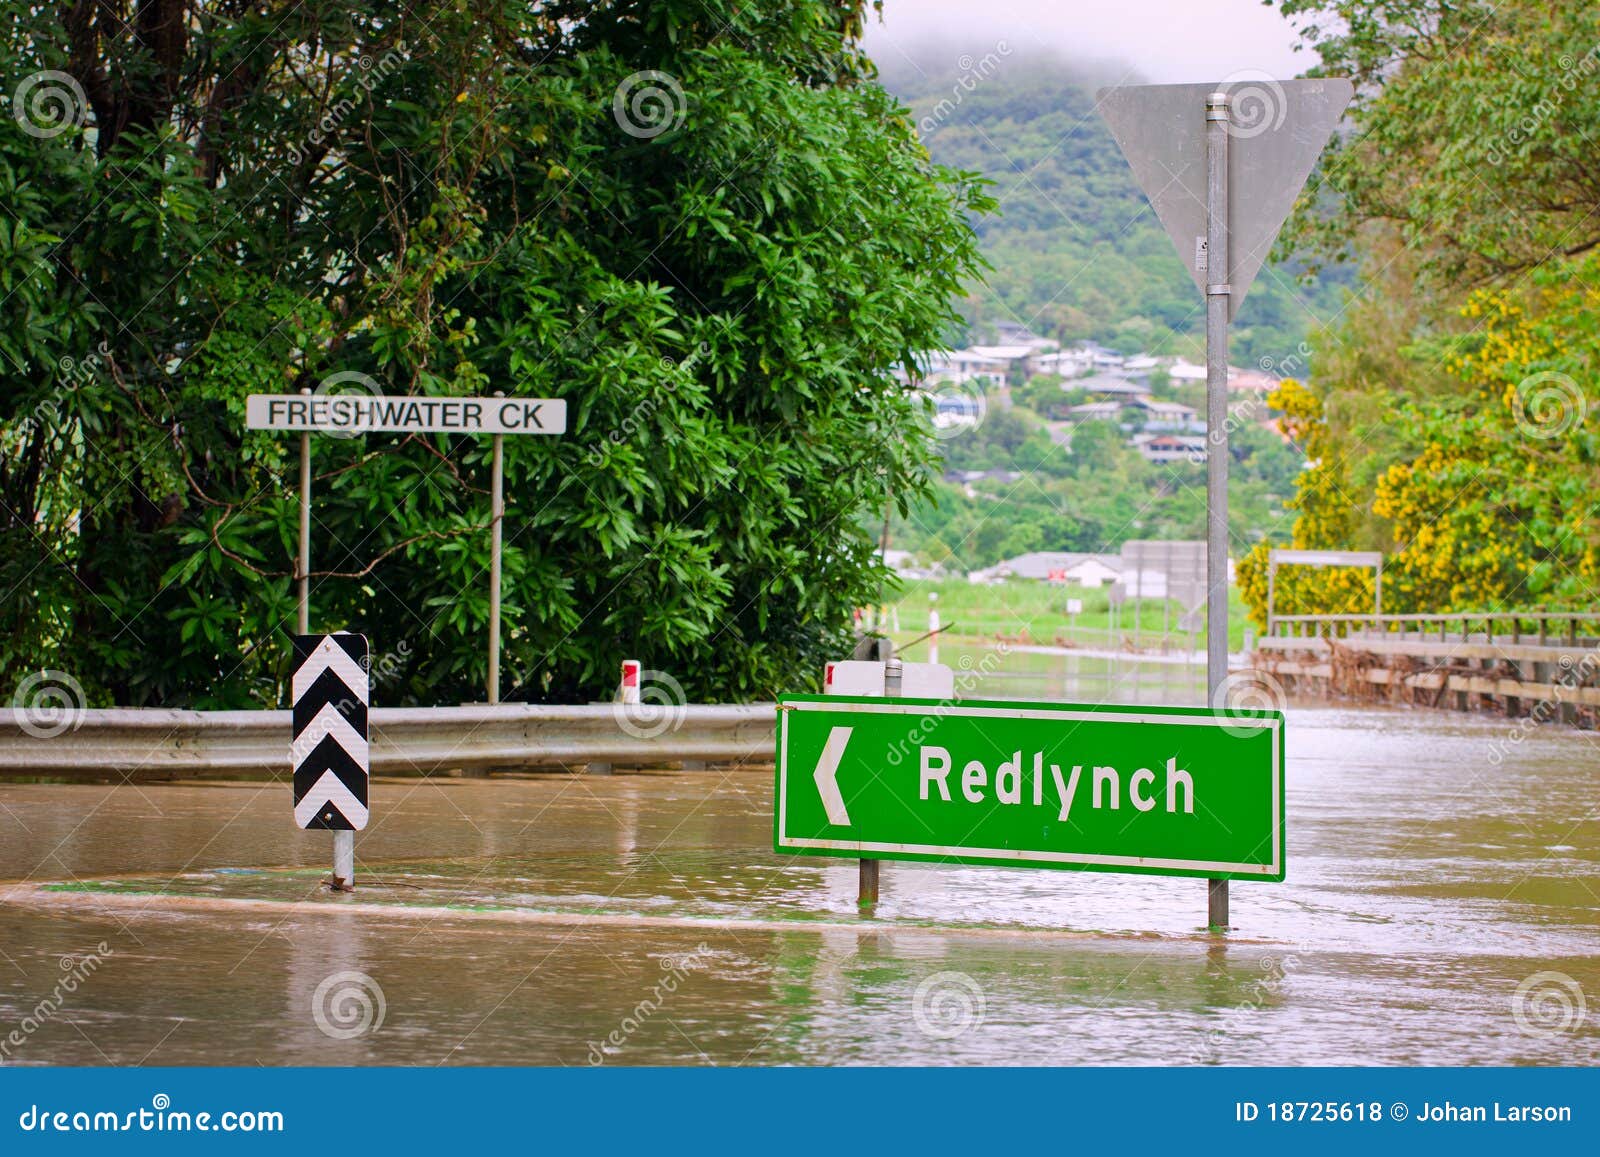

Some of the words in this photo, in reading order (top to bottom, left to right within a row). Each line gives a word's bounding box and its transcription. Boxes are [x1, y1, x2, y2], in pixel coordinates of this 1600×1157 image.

[268, 400, 482, 428] FRESHWATER
[500, 403, 544, 429] CK
[919, 745, 1194, 822] Redlynch
